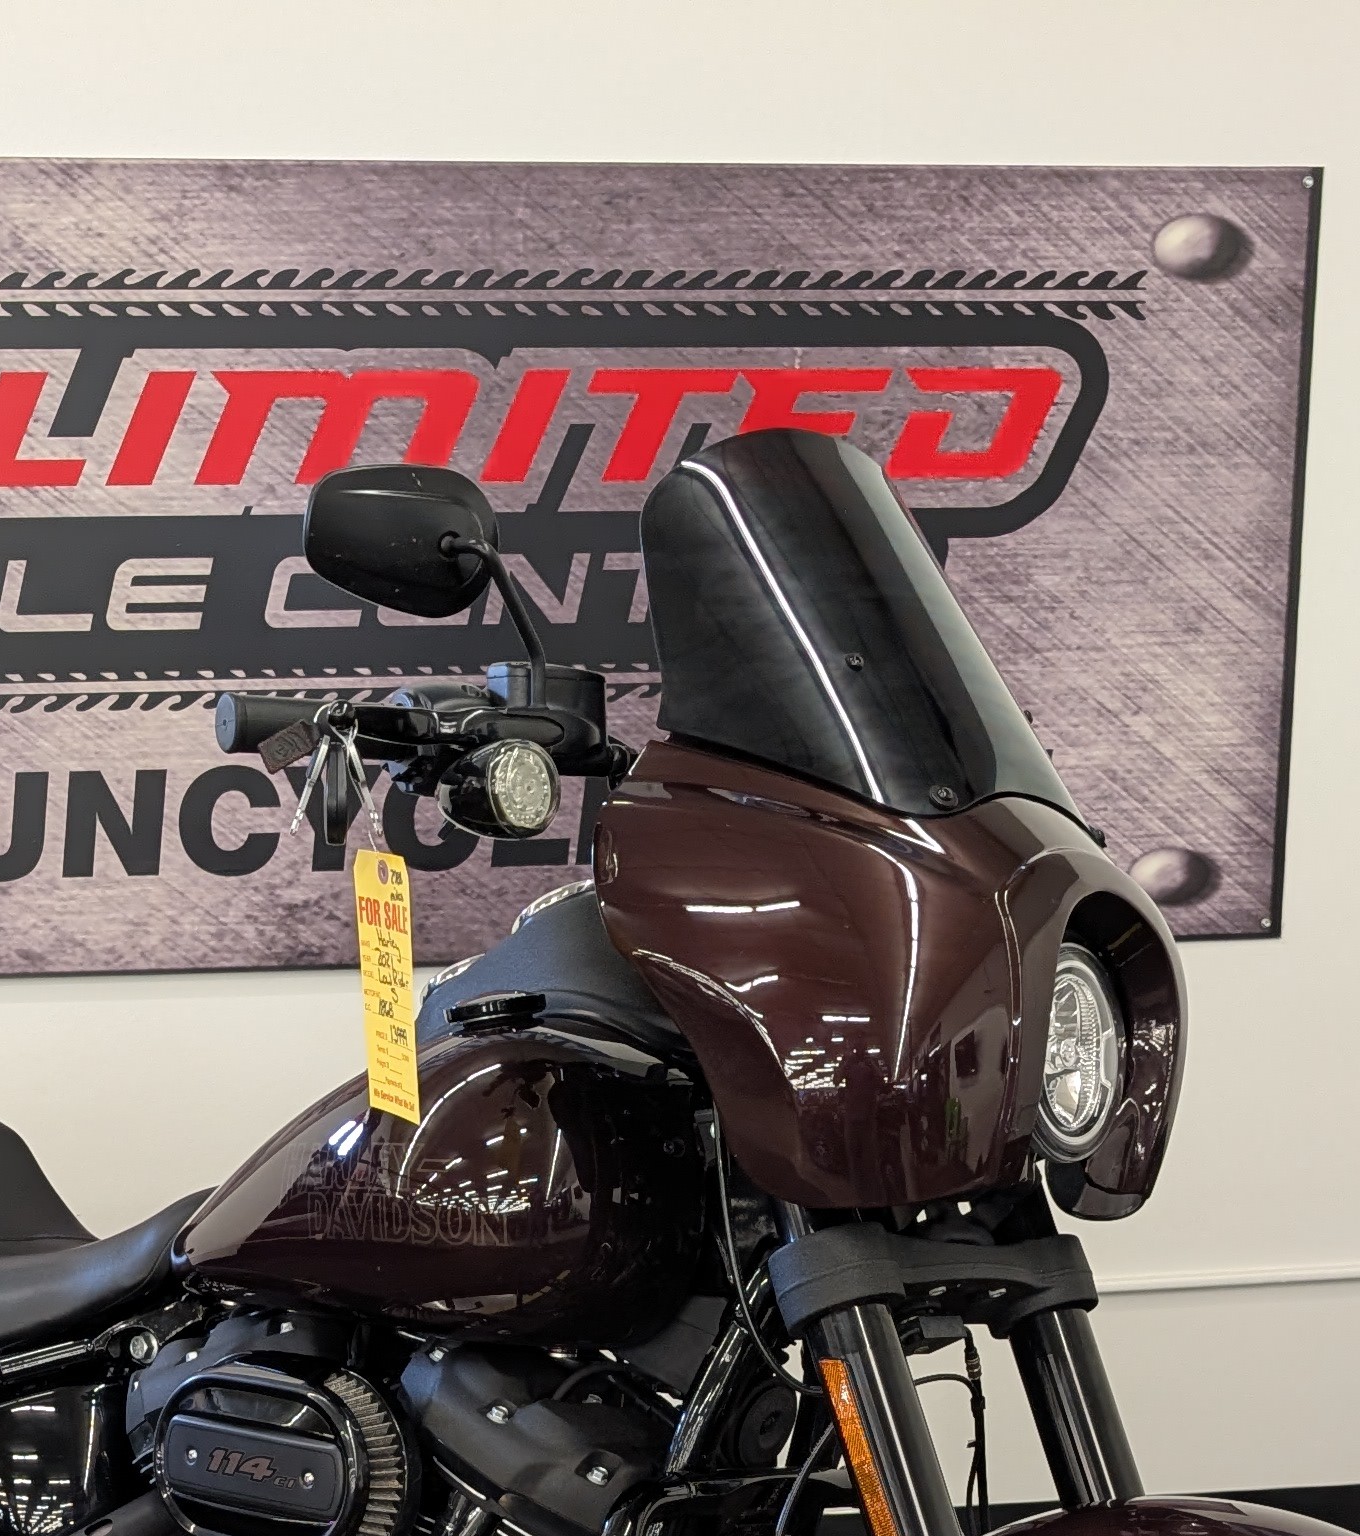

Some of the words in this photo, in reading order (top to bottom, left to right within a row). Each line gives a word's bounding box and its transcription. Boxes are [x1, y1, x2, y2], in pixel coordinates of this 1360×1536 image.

[358, 895, 382, 928] FOR
[383, 900, 409, 935] SALE
[307, 1191, 510, 1247] DAVIDSON
[205, 1446, 278, 1483] 114
[273, 1475, 297, 1489] CI
